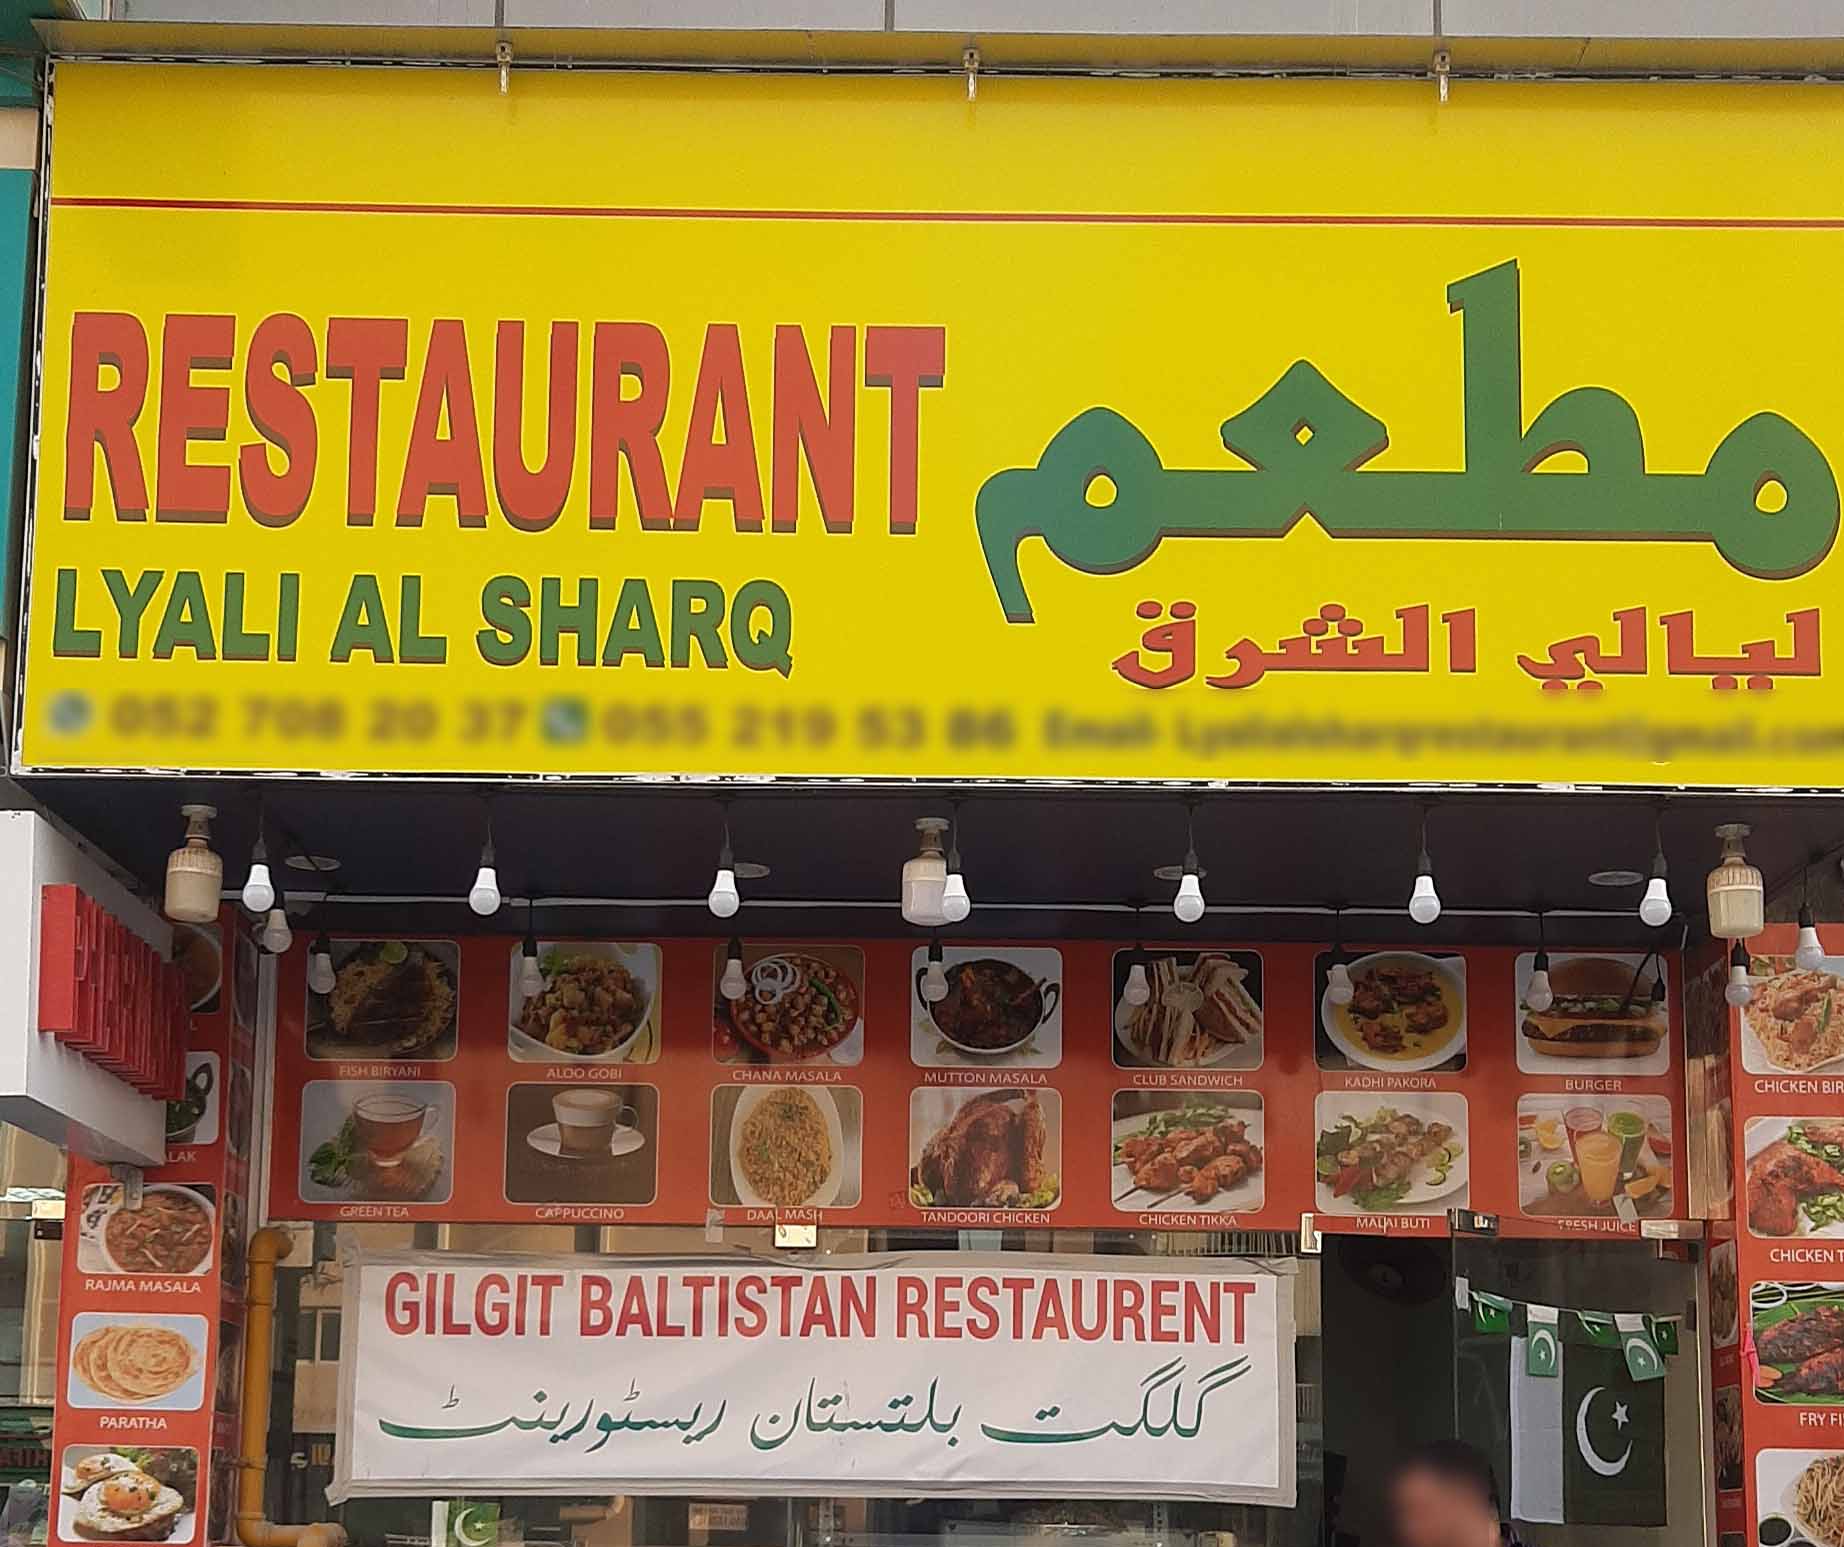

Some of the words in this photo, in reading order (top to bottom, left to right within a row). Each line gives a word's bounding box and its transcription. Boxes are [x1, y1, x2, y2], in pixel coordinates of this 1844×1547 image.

[62, 312, 946, 535] RESTAURANT
[975, 259, 1840, 624] مطعم
[52, 568, 300, 662] LYALI
[330, 574, 447, 665] AL
[476, 576, 794, 678] SHARQ
[1112, 600, 1476, 690] الشرق
[1517, 606, 1822, 690] ليالي
[339, 1065, 366, 1077] FISH
[368, 1065, 421, 1079] BIRYANI
[546, 1067, 585, 1080] ALOO
[588, 1068, 622, 1080] GOBI
[732, 1069, 784, 1082] CHANA
[785, 1070, 841, 1082] MASALA
[925, 1072, 985, 1084] MUTTON
[988, 1073, 1047, 1085] MASALA
[1133, 1074, 1166, 1086] CLUB
[1169, 1073, 1243, 1088] SANDWICH
[1345, 1076, 1383, 1088] KADHI
[1386, 1077, 1436, 1089] PAKORA
[1565, 1079, 1622, 1092] BURGER
[1754, 1079, 1817, 1094] CHICKEN
[166, 1150, 197, 1163] LAK
[339, 1205, 385, 1218] GREEN
[387, 1206, 409, 1218] TEA
[535, 1206, 624, 1220] CAPPUCCINO
[746, 1210, 783, 1222] DAAL
[785, 1210, 823, 1222] MASH
[921, 1211, 991, 1224] TANDOORI
[994, 1212, 1050, 1224] CHICKEN
[1139, 1213, 1196, 1225] CHICKEN
[1199, 1213, 1237, 1227] TIKKA
[1356, 1216, 1398, 1230] MALAI
[1401, 1217, 1431, 1230] BUTI
[1558, 1219, 1598, 1231] FRESH
[1600, 1220, 1636, 1232] JUICE
[1770, 1248, 1834, 1263] CHICKEN
[84, 1278, 135, 1294] RAJMA
[138, 1279, 202, 1295] MASALA
[385, 1271, 564, 1336] GILGIT
[579, 1275, 877, 1339] BALTISTAN
[897, 1276, 1256, 1343] RESTAURENT
[981, 1355, 1252, 1443] گلگت
[750, 1375, 962, 1451] بلتستان
[1799, 1412, 1826, 1426] FRY
[1830, 1412, 1844, 1427] FI
[99, 1416, 168, 1431] PARATHA
